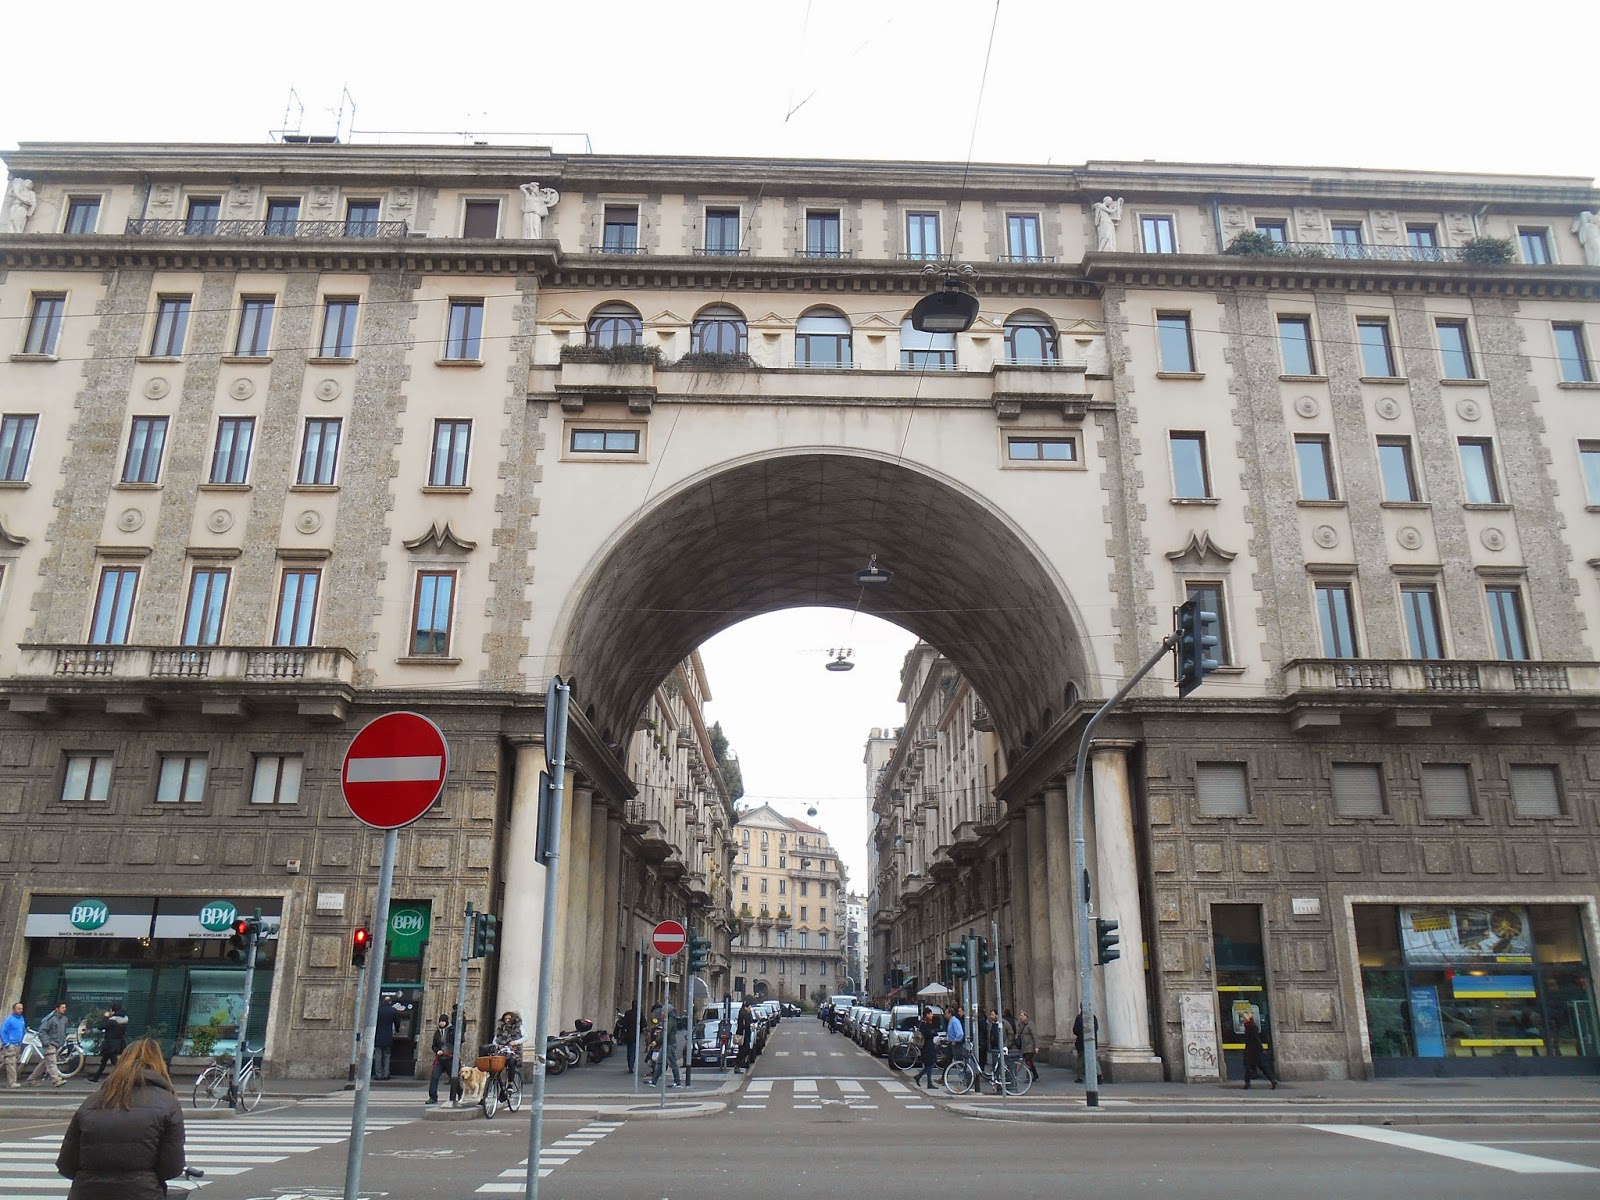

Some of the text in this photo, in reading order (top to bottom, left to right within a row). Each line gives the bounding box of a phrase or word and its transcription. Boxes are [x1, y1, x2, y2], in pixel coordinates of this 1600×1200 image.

[71, 906, 107, 923] BPM
[201, 908, 235, 924] BPM
[394, 915, 421, 929] BPM
